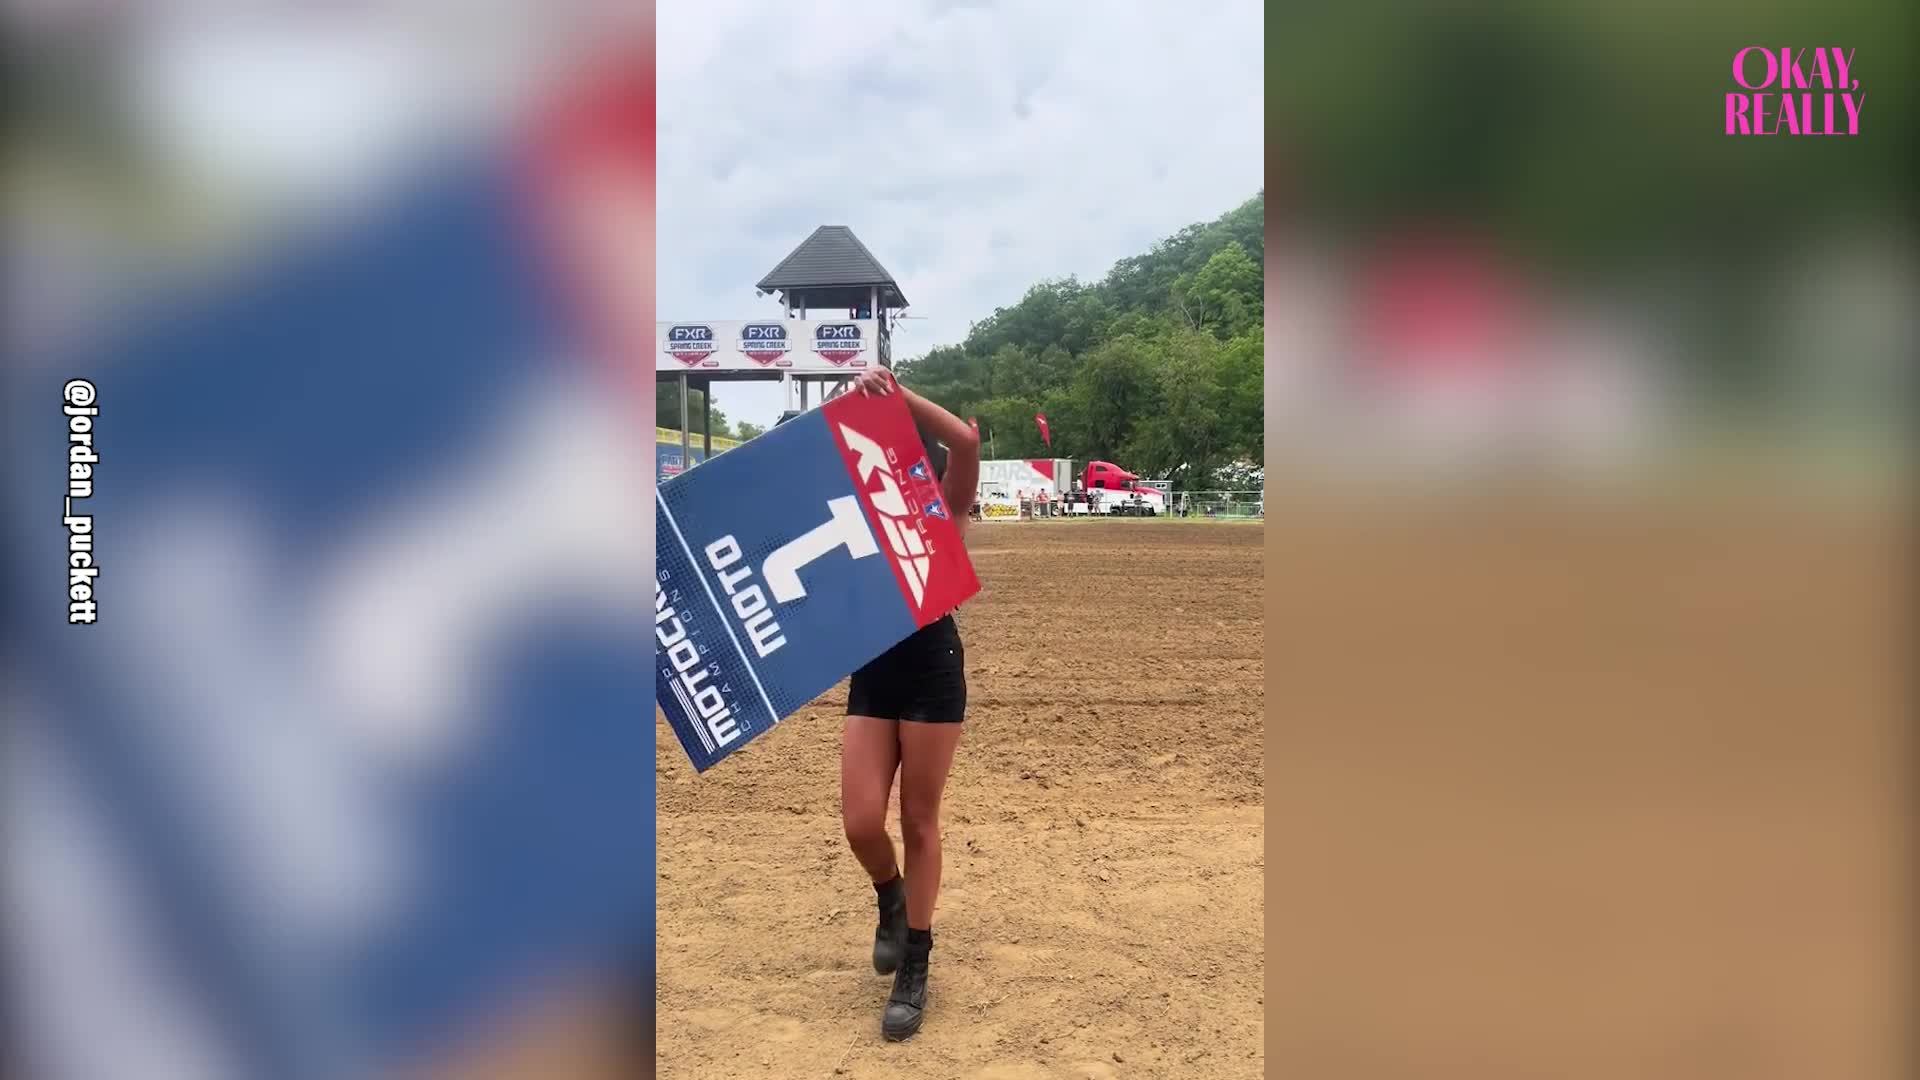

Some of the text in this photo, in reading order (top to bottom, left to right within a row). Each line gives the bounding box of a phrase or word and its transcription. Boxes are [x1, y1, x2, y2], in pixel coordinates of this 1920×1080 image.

[675, 328, 706, 339] FXR
[748, 327, 780, 338] FXR
[822, 327, 854, 338] FXR
[762, 494, 880, 604] 1
[838, 422, 930, 610] FLY
[887, 447, 936, 555] RACING
[656, 556, 752, 732] CHAMPIONS
[705, 534, 787, 659] MOTO
